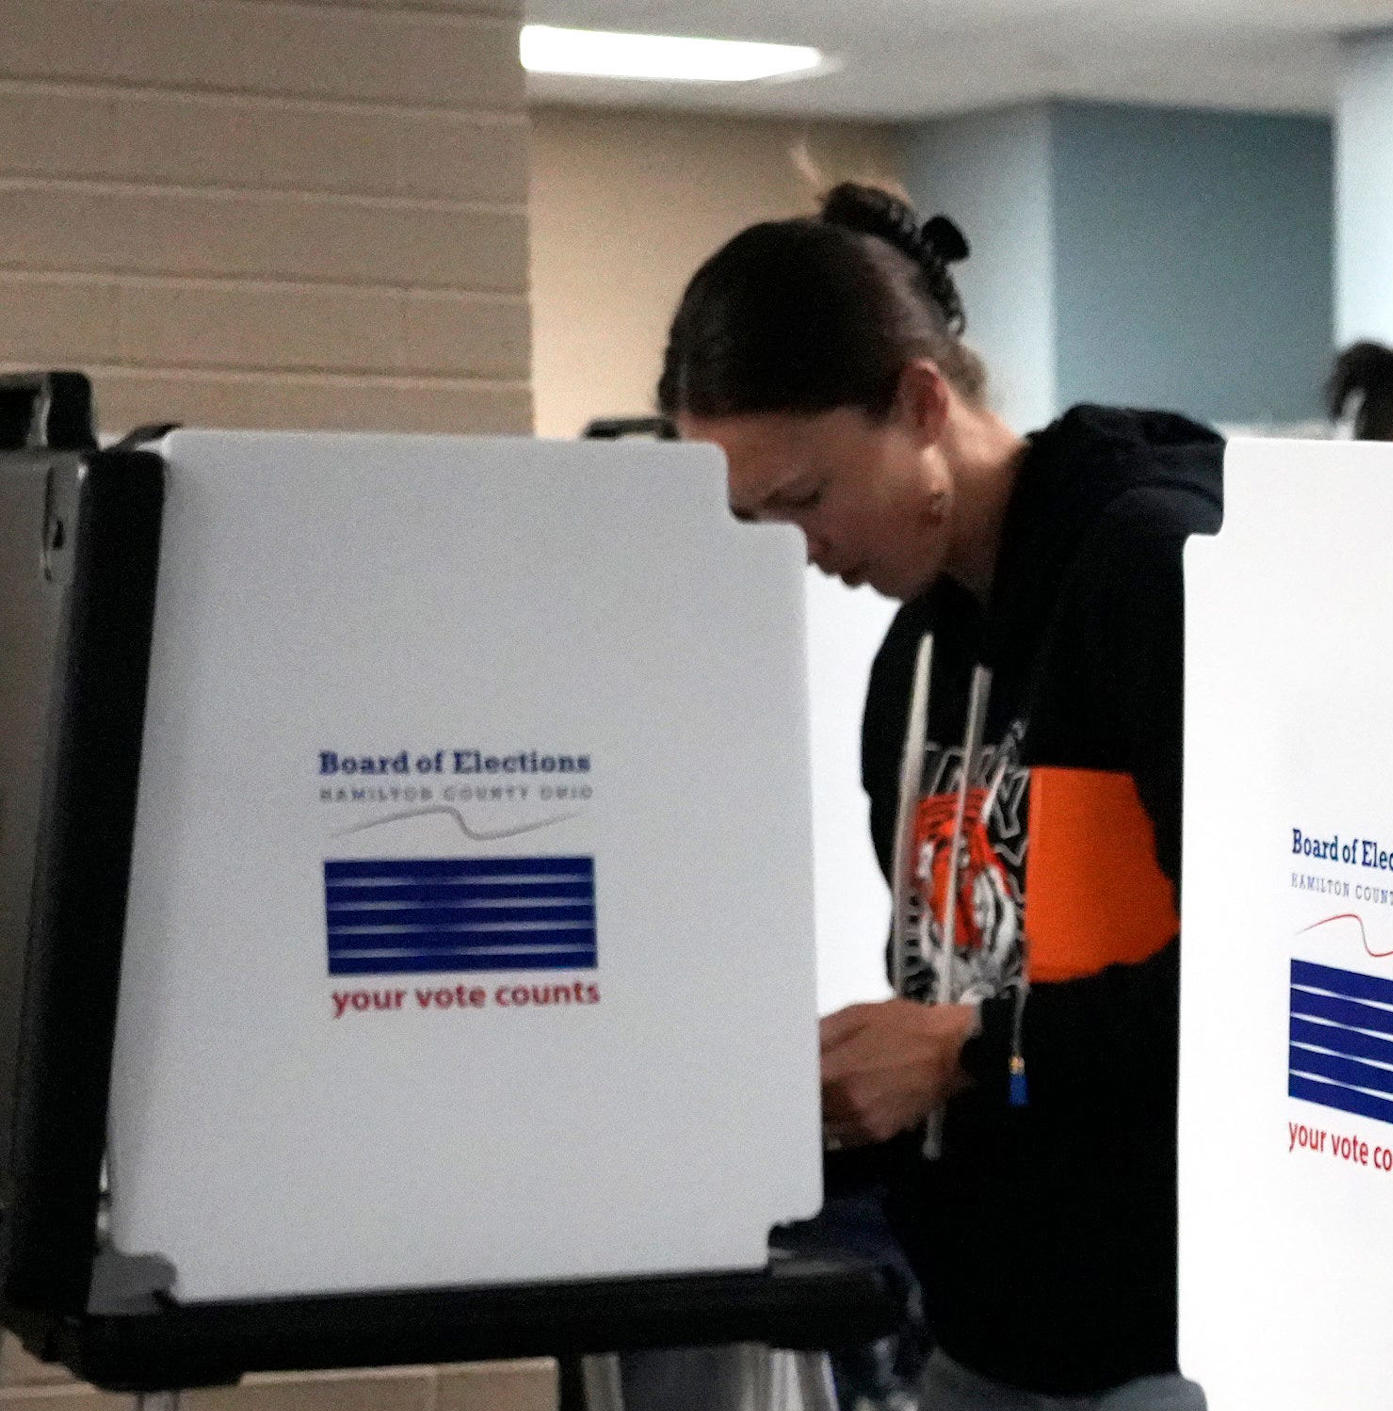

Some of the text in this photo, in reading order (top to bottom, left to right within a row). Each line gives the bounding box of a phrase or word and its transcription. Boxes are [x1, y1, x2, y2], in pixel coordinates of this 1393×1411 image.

[319, 750, 592, 775] Board of Elections
[443, 786, 529, 800] COUNTY
[1292, 828, 1339, 862] Board
[1342, 838, 1358, 865] of
[1291, 872, 1350, 897] HAMILTON
[331, 980, 601, 1020] your vote counts
[1288, 1120, 1327, 1153] your
[1332, 1134, 1369, 1167] vote
